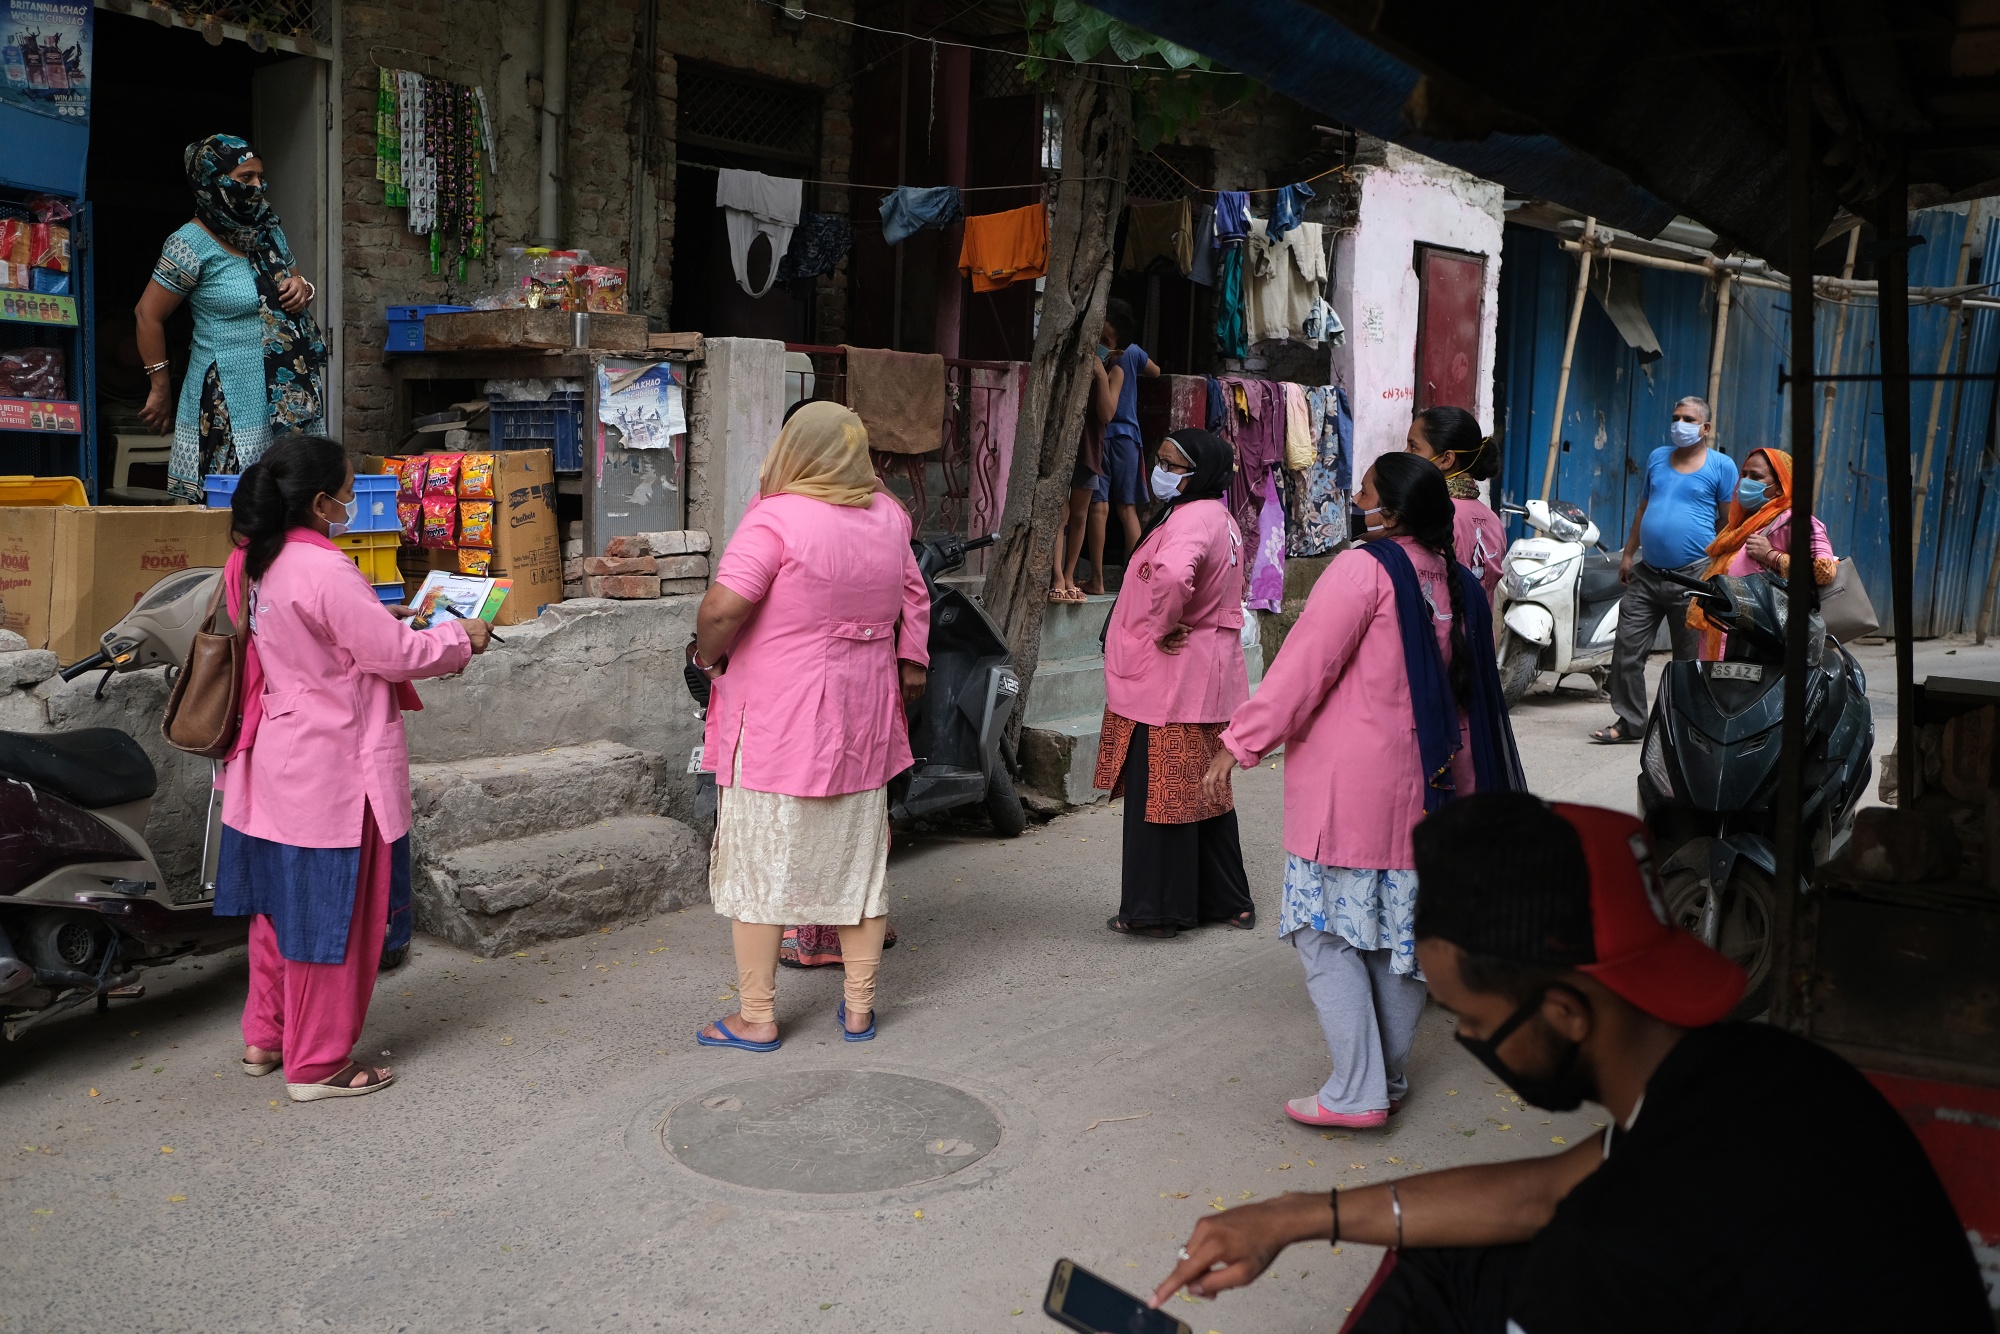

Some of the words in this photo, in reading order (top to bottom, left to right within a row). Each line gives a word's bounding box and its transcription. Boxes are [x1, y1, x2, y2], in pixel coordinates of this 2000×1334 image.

[10, 0, 58, 13] BRITANNIA
[60, 5, 86, 16] KHAO
[11, 11, 44, 21] WORLD
[45, 15, 63, 24] CUP
[66, 17, 84, 26] JAO
[598, 275, 622, 288] Merlin
[641, 378, 660, 389] KHAO
[645, 387, 660, 397] JAO
[4, 404, 24, 413] BETTER
[1, 553, 29, 572] POOJA
[141, 553, 188, 571] POOJA
